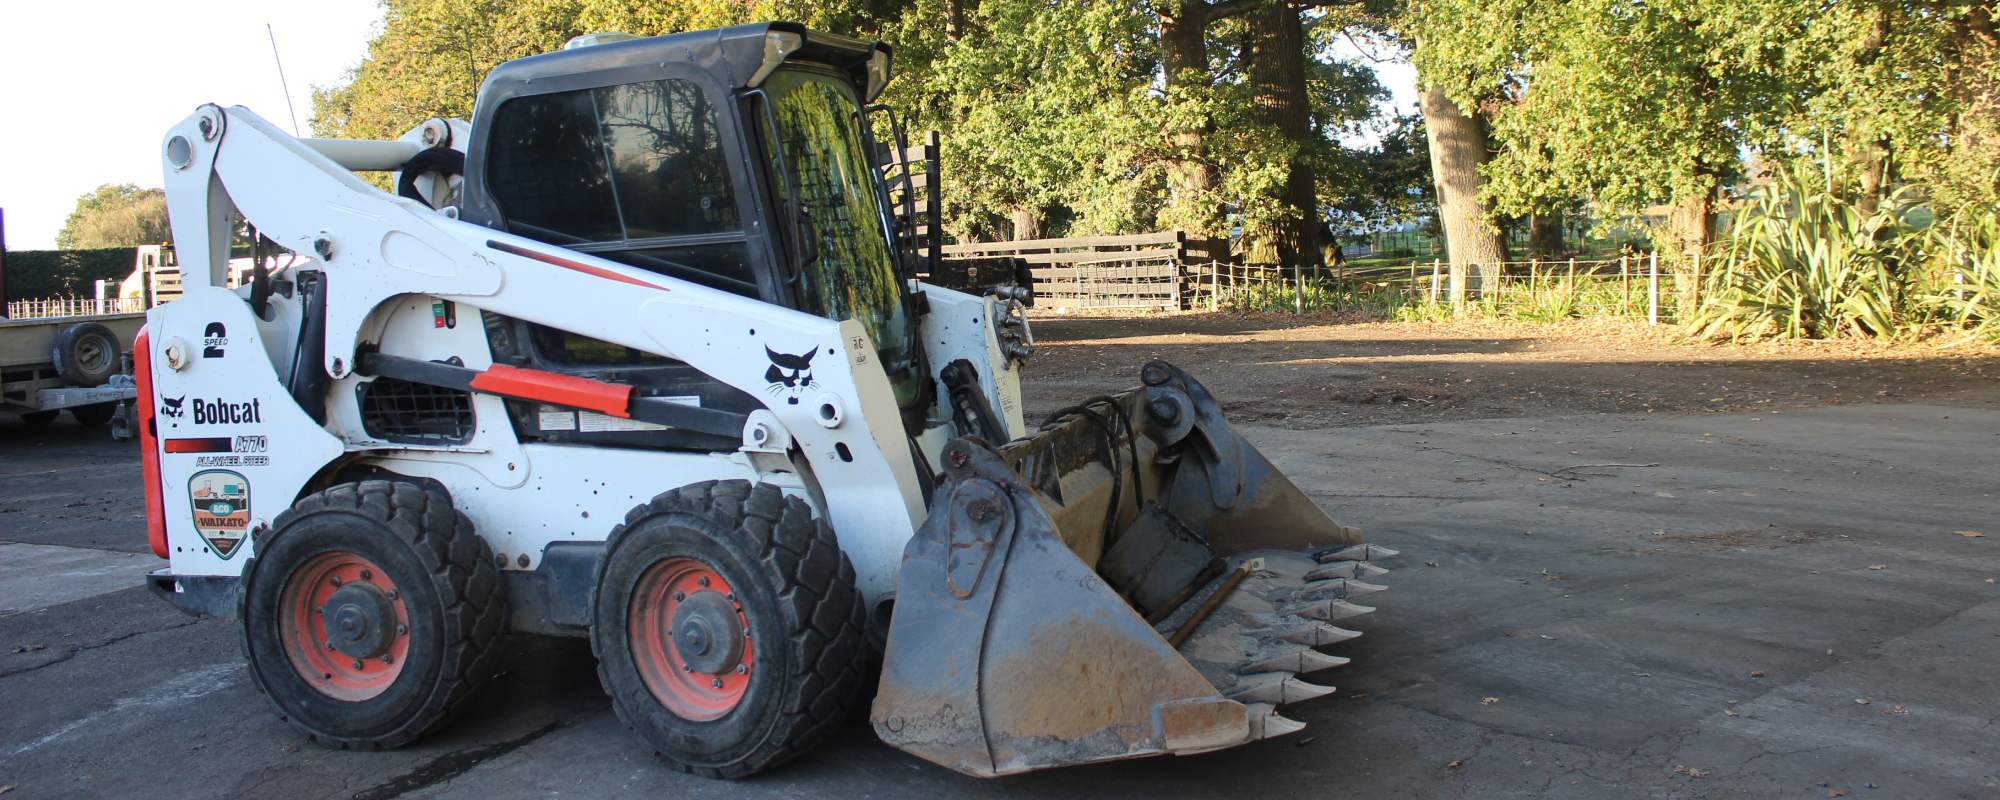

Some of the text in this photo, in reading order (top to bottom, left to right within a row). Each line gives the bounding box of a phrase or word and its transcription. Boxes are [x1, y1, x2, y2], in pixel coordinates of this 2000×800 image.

[203, 321, 226, 358] 2
[204, 338, 229, 346] SPEED
[192, 397, 261, 425] Bobcat
[234, 435, 268, 453] A770
[242, 456, 269, 467] STEER
